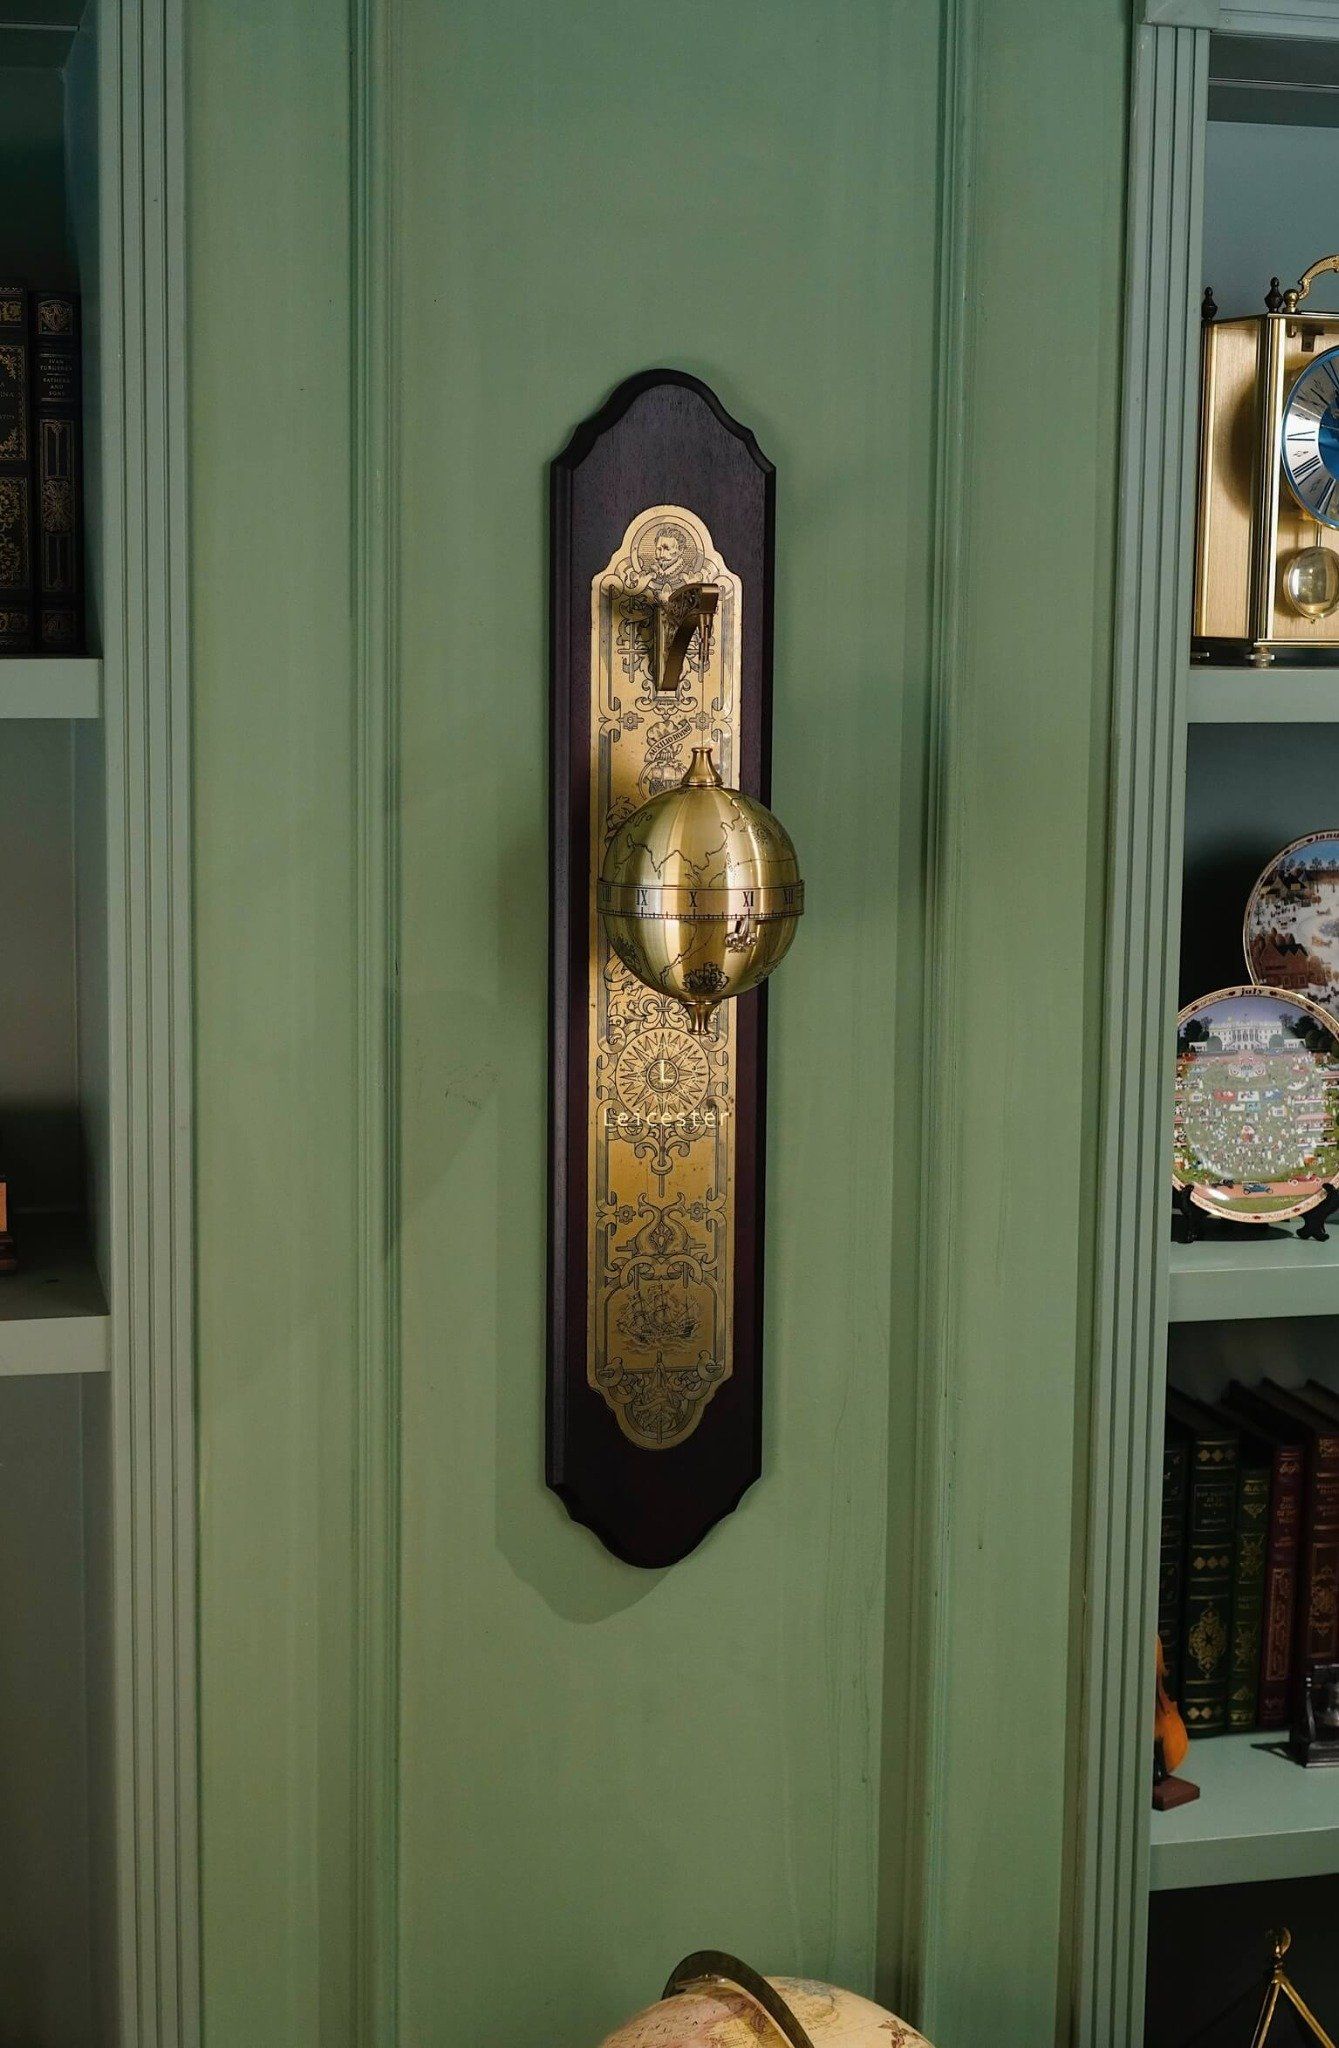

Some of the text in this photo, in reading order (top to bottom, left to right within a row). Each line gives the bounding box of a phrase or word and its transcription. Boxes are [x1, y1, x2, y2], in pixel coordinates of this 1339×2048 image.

[649, 736, 674, 757] AUXILIO
[636, 889, 648, 906] IX
[689, 891, 699, 908] X
[742, 891, 754, 907] XI
